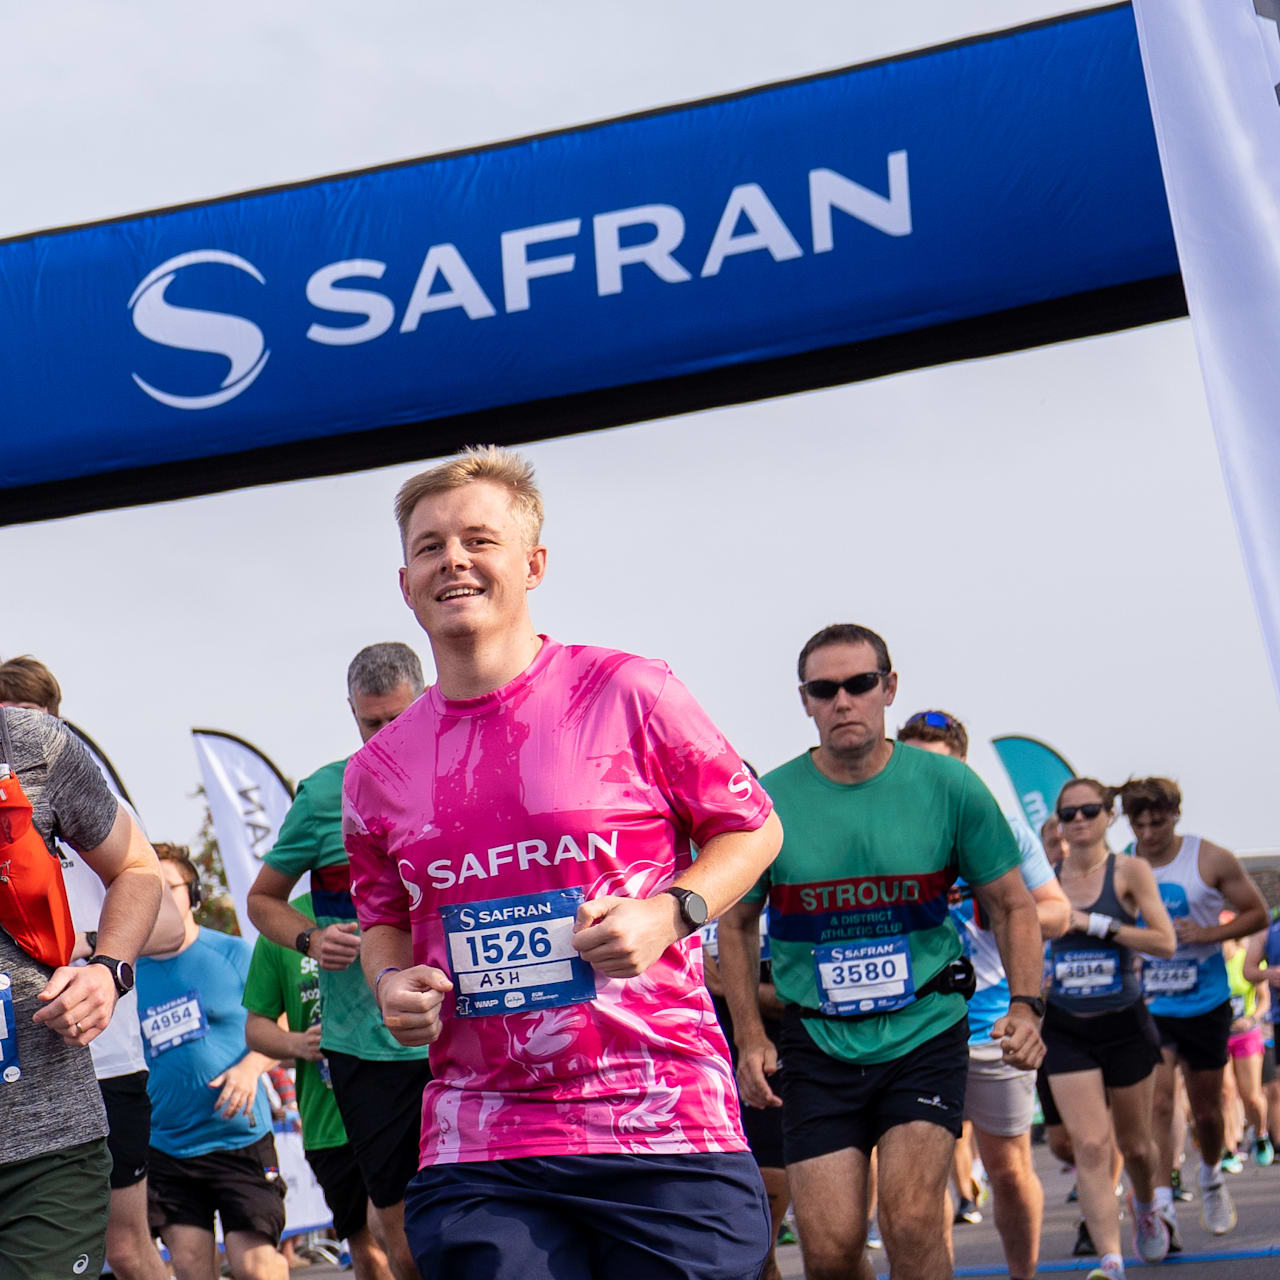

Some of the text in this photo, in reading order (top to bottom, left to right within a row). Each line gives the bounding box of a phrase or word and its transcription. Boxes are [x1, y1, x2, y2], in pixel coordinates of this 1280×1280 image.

[306, 151, 912, 345] SAFRAN
[427, 830, 619, 890] SAFRAN
[800, 880, 920, 911] STROUD
[478, 902, 552, 923] SAFRAN
[841, 911, 892, 924] DISTRICT
[821, 926, 873, 940] ATHLETIC
[466, 926, 553, 967] 1526
[844, 944, 894, 958] SAFRAN
[480, 971, 521, 988] ASH
[832, 959, 896, 985] 3580
[151, 1006, 193, 1032] 4954
